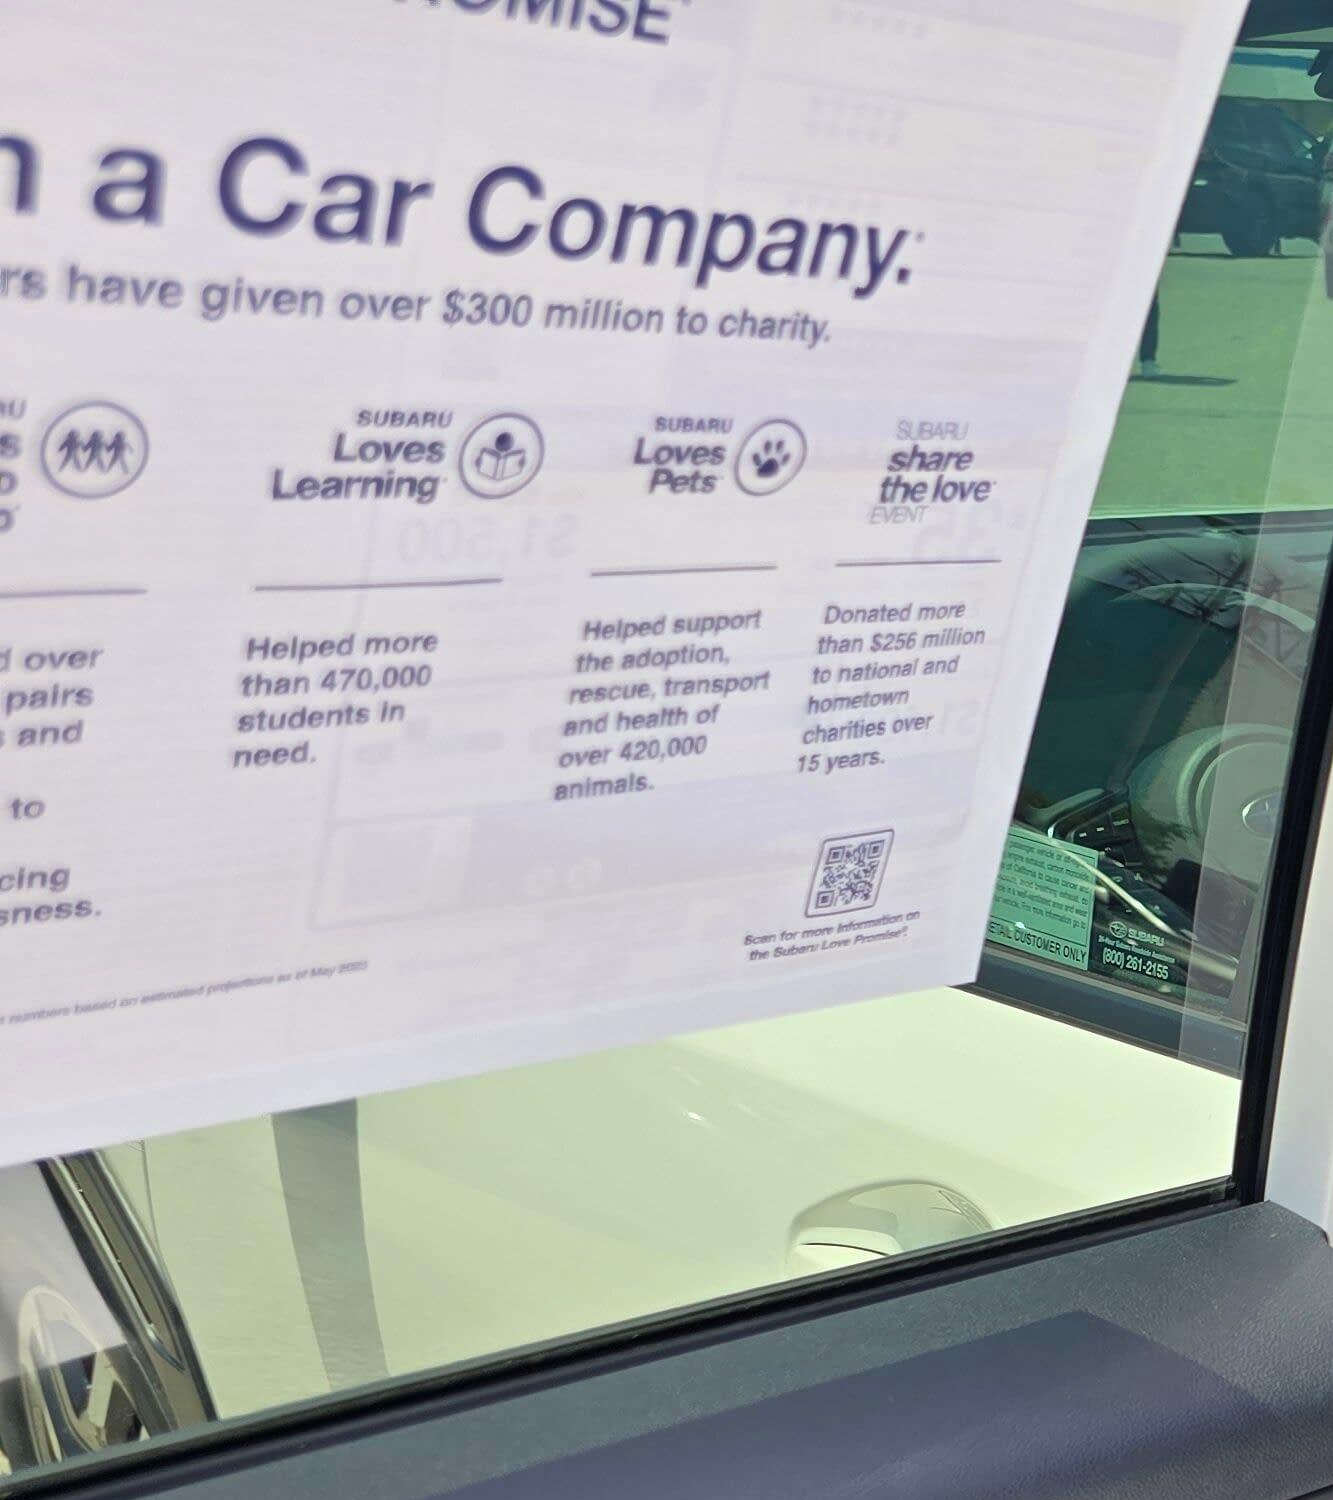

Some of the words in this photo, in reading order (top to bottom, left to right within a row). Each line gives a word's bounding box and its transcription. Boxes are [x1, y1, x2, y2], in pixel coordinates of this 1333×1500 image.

[92, 145, 165, 225] a
[217, 136, 434, 246] Car
[466, 165, 912, 299] Company.
[67, 264, 184, 308] have
[201, 277, 322, 321] given
[339, 292, 432, 322] over
[441, 290, 533, 329] $300
[544, 298, 664, 335] million
[675, 306, 708, 336] to
[718, 307, 831, 349] charity.
[356, 410, 454, 428] SUBARU
[655, 416, 734, 434] SUBARU
[897, 420, 969, 441] SUBARU
[333, 433, 446, 464] Loves
[633, 437, 726, 467] Loves
[887, 444, 975, 473] share
[272, 468, 441, 503] Learning
[648, 467, 717, 495] Pets
[878, 475, 929, 504] the
[932, 476, 992, 503] love
[868, 504, 930, 525] EVENT
[582, 613, 668, 644] Helped
[672, 609, 763, 638] support
[823, 602, 912, 627] Donated
[916, 601, 966, 621] more
[246, 633, 354, 665] Helped
[363, 631, 439, 656] more
[817, 632, 864, 656] than
[870, 629, 917, 654] $256
[921, 626, 986, 650] million
[24, 648, 104, 671] over
[576, 652, 617, 674] the
[621, 645, 731, 670] adoption,
[812, 666, 832, 686] to
[837, 657, 919, 683] national
[922, 655, 960, 676] and
[241, 669, 311, 698] than
[320, 664, 432, 695] 470,000
[568, 679, 657, 705] rescue,
[663, 670, 771, 701] transport
[6, 682, 95, 717] pairs
[806, 689, 910, 716] hometown
[237, 704, 370, 734] students
[380, 701, 406, 722] in
[562, 712, 609, 738] and
[615, 706, 689, 734] health
[696, 703, 721, 726] of
[802, 718, 887, 746] charities
[891, 713, 934, 734] over
[17, 719, 84, 748] and
[232, 740, 317, 768] need.
[558, 746, 611, 769] over
[619, 735, 708, 765] 420,000
[797, 753, 820, 774] 15
[825, 749, 886, 776] years.
[553, 772, 655, 802] animals.
[9, 797, 46, 821] to
[744, 932, 776, 947] Scan
[781, 929, 798, 941] for
[750, 948, 769, 961] the
[821, 936, 850, 951] Love
[1014, 929, 1062, 957] CUSTOMER
[1062, 944, 1087, 964] ONLY
[1127, 927, 1165, 947] SUBARU
[1102, 946, 1125, 970] (800)
[1125, 955, 1169, 980] 261-2155
